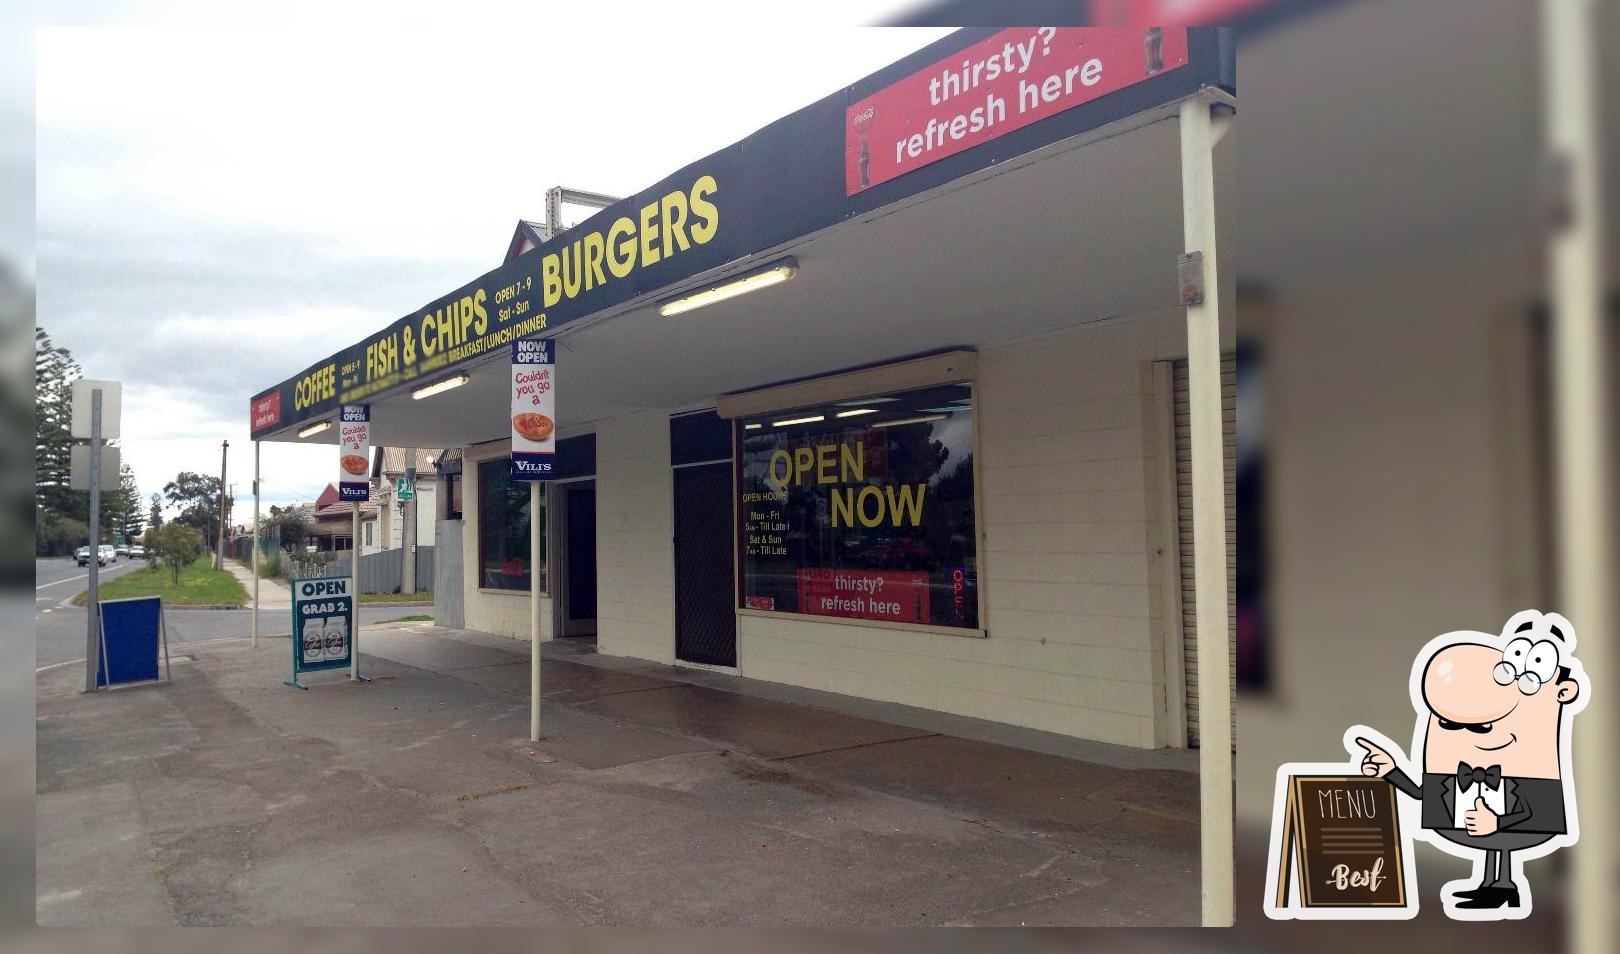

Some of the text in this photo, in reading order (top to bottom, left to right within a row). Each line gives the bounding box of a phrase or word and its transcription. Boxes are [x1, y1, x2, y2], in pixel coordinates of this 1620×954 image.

[929, 27, 1057, 105] thirsty?
[896, 58, 1103, 163] refresh here
[542, 175, 718, 308] BURGERS
[495, 284, 514, 304] OPEN
[517, 281, 520, 294] 7
[526, 276, 532, 290] 9
[498, 305, 510, 322] Sat
[516, 300, 529, 315] Sun
[366, 332, 398, 382] FISH
[403, 325, 415, 365] &
[421, 289, 488, 356] CHIPS
[518, 341, 546, 351] NOW
[517, 352, 548, 363] OPEN
[295, 363, 336, 411] COFFEE
[516, 381, 550, 399] you go
[532, 394, 540, 405] a
[343, 405, 364, 414] NOW
[343, 413, 366, 421] OPEN
[342, 433, 366, 446] you go
[769, 441, 864, 487] OPEN
[742, 493, 761, 502] OPEN
[831, 483, 926, 528] NOW
[751, 511, 765, 520] Mon
[770, 510, 780, 520] Fri
[760, 521, 769, 531] Till
[771, 521, 785, 531] Late
[750, 535, 760, 544] Sat
[768, 535, 782, 544] Sun
[760, 545, 770, 555] Till
[772, 546, 787, 555] Late
[302, 580, 346, 597] OPEN
[834, 575, 884, 594] thirsty?
[302, 602, 335, 615] GRAB
[821, 595, 901, 615] refresh here
